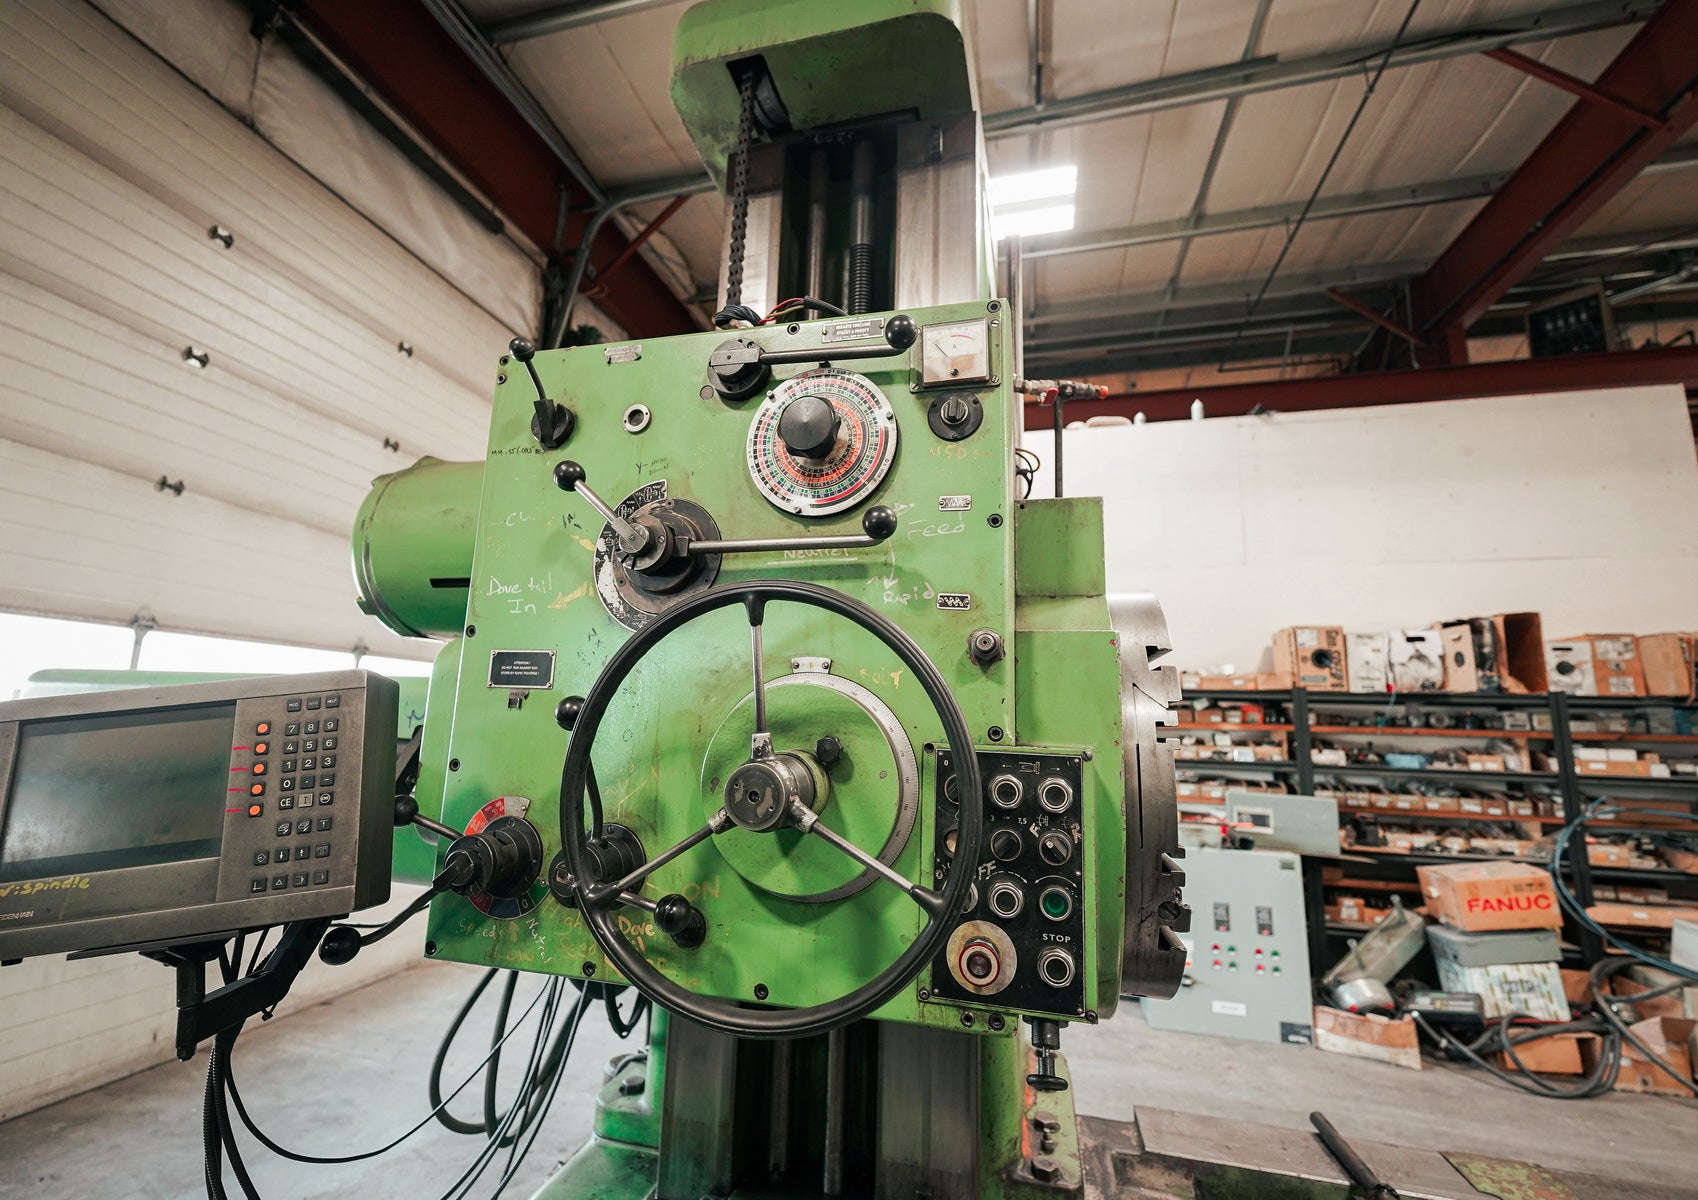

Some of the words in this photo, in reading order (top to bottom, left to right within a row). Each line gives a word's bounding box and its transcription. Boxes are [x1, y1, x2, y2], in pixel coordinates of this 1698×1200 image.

[905, 511, 966, 540] Feed
[486, 576, 522, 596] Dove
[288, 724, 296, 733] 7
[307, 723, 314, 732] 8
[326, 721, 334, 730] 9
[286, 743, 294, 751] 4
[306, 740, 313, 749] 5
[325, 739, 333, 747] 6
[286, 761, 291, 769] 1
[304, 759, 312, 767] 2
[324, 757, 332, 766] 3
[280, 797, 291, 807] CE
[1467, 894, 1552, 913] FANUC
[618, 915, 655, 937] Dove
[1042, 933, 1071, 943] STOP
